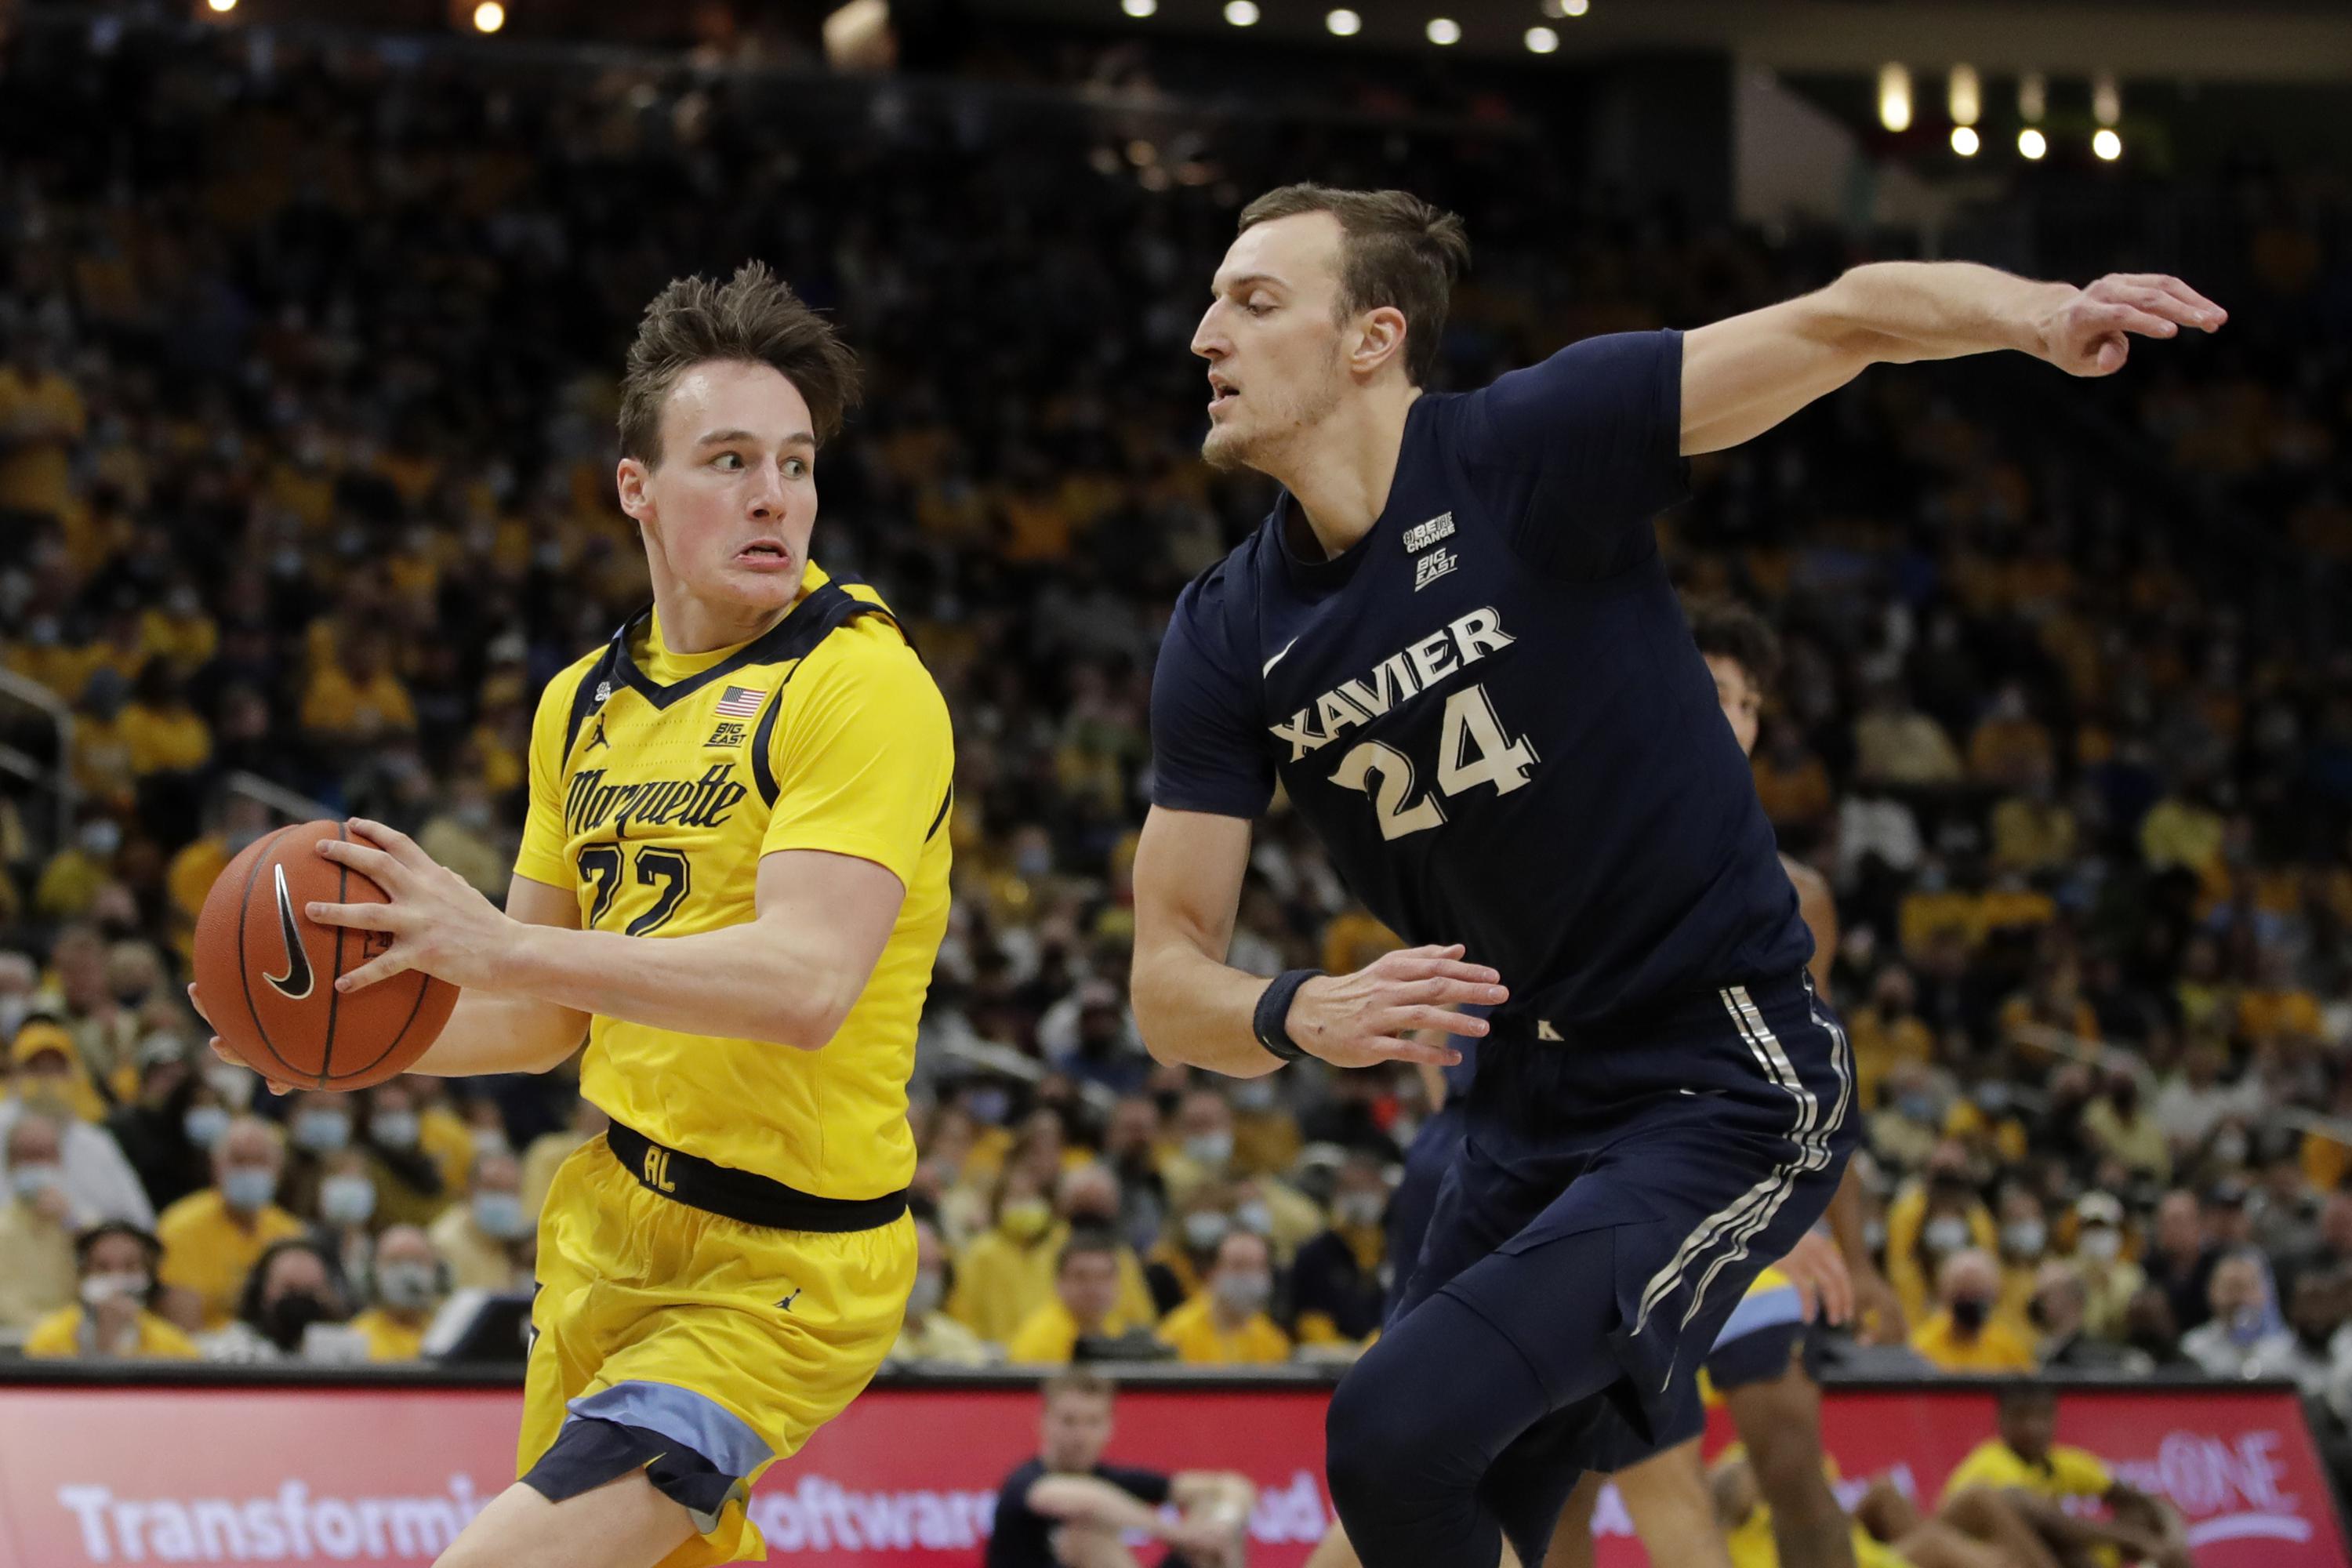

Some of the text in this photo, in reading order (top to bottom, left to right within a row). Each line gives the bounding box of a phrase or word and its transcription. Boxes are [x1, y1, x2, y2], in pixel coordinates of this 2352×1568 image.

[1406, 523, 1456, 554] CHANGE
[1415, 554, 1458, 586] EAST
[1416, 547, 1446, 573] BIG
[1268, 605, 1517, 764] XAVIER
[708, 733, 747, 745] EAST
[714, 722, 745, 734] BIG
[1327, 682, 1541, 842] 24
[564, 763, 748, 840] Marquette
[644, 1145, 676, 1193] AL
[57, 1471, 997, 1565] Transformi oftwar
